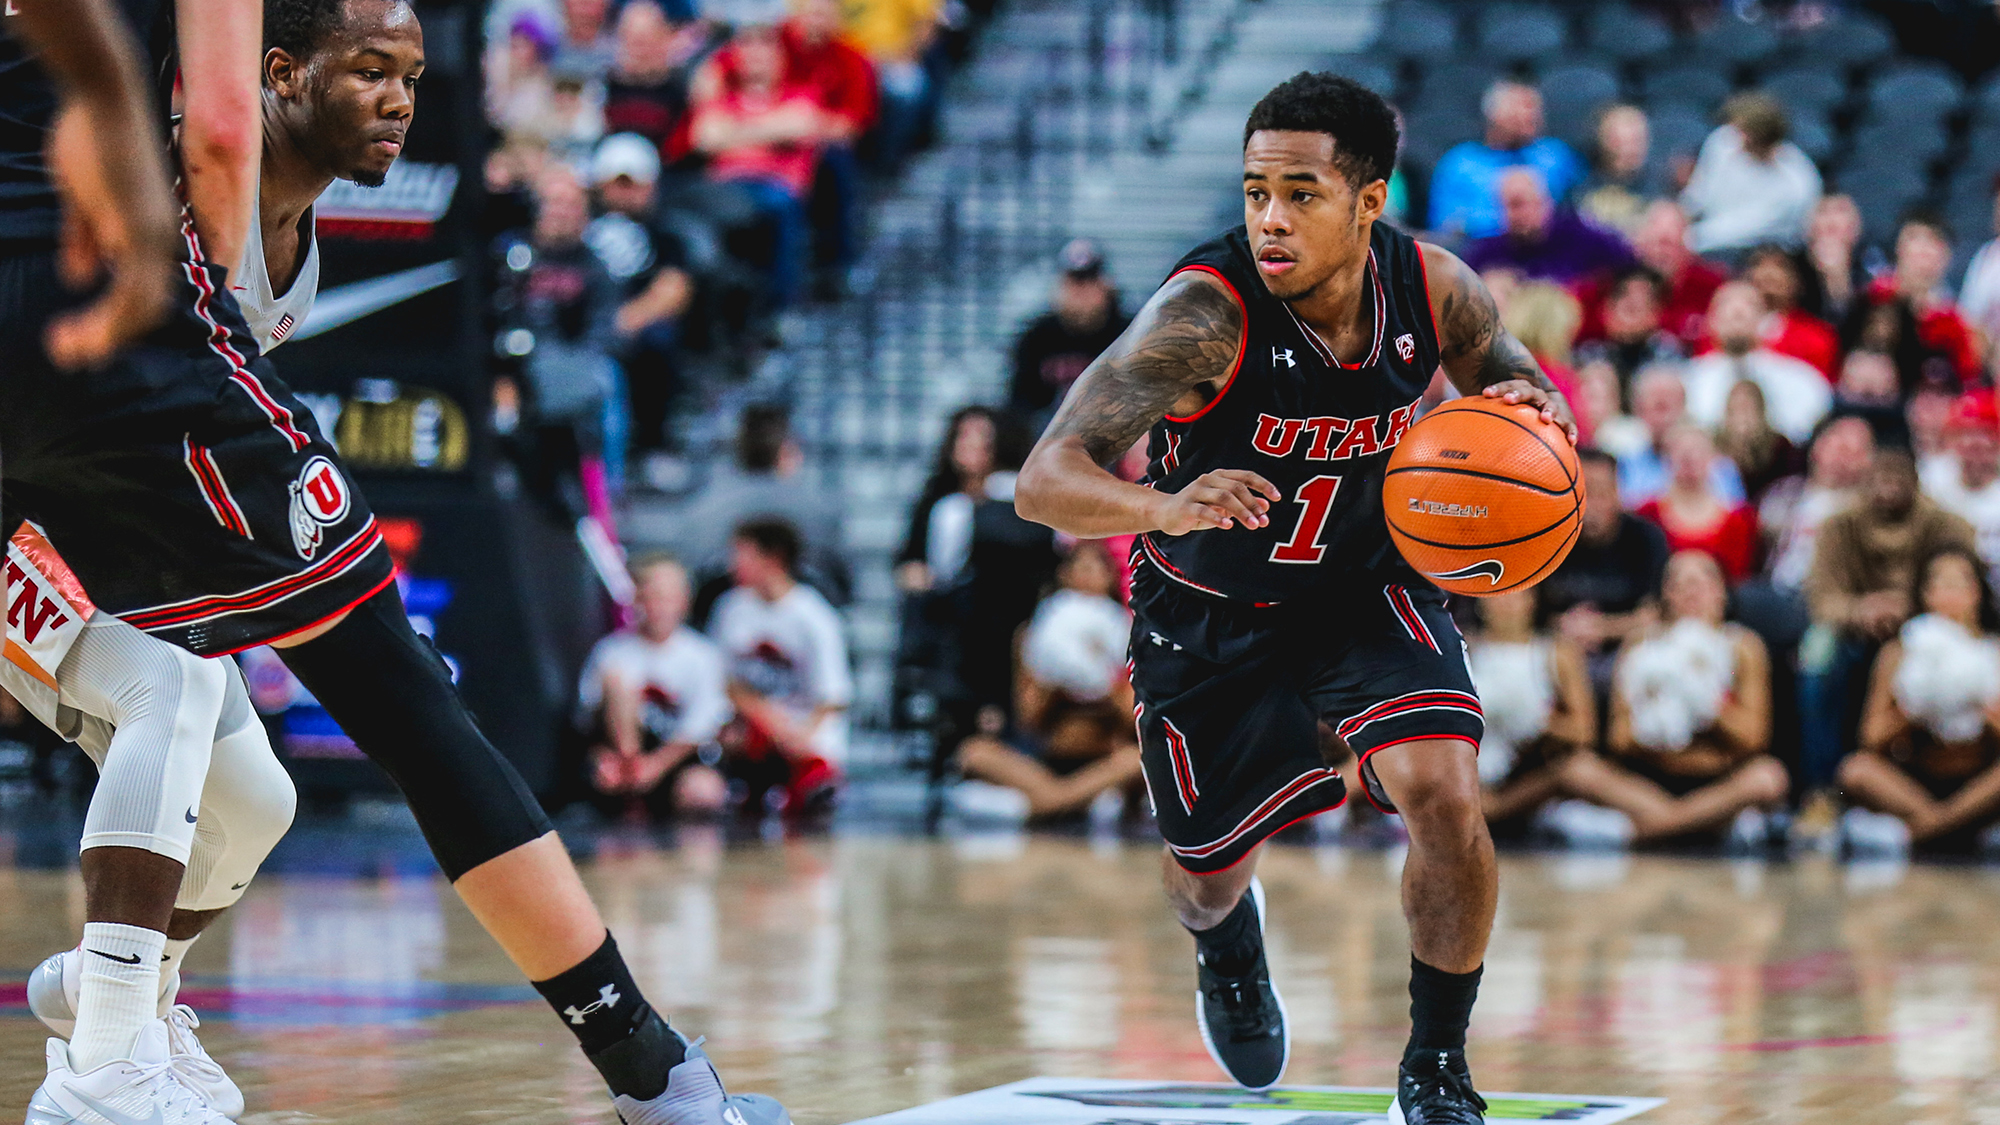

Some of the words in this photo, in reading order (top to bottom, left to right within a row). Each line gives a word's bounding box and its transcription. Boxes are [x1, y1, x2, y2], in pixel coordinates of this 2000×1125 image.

[1403, 346, 1414, 361] 12
[1252, 396, 1423, 461] UTAH
[306, 466, 342, 516] U
[1268, 474, 1343, 564] 1
